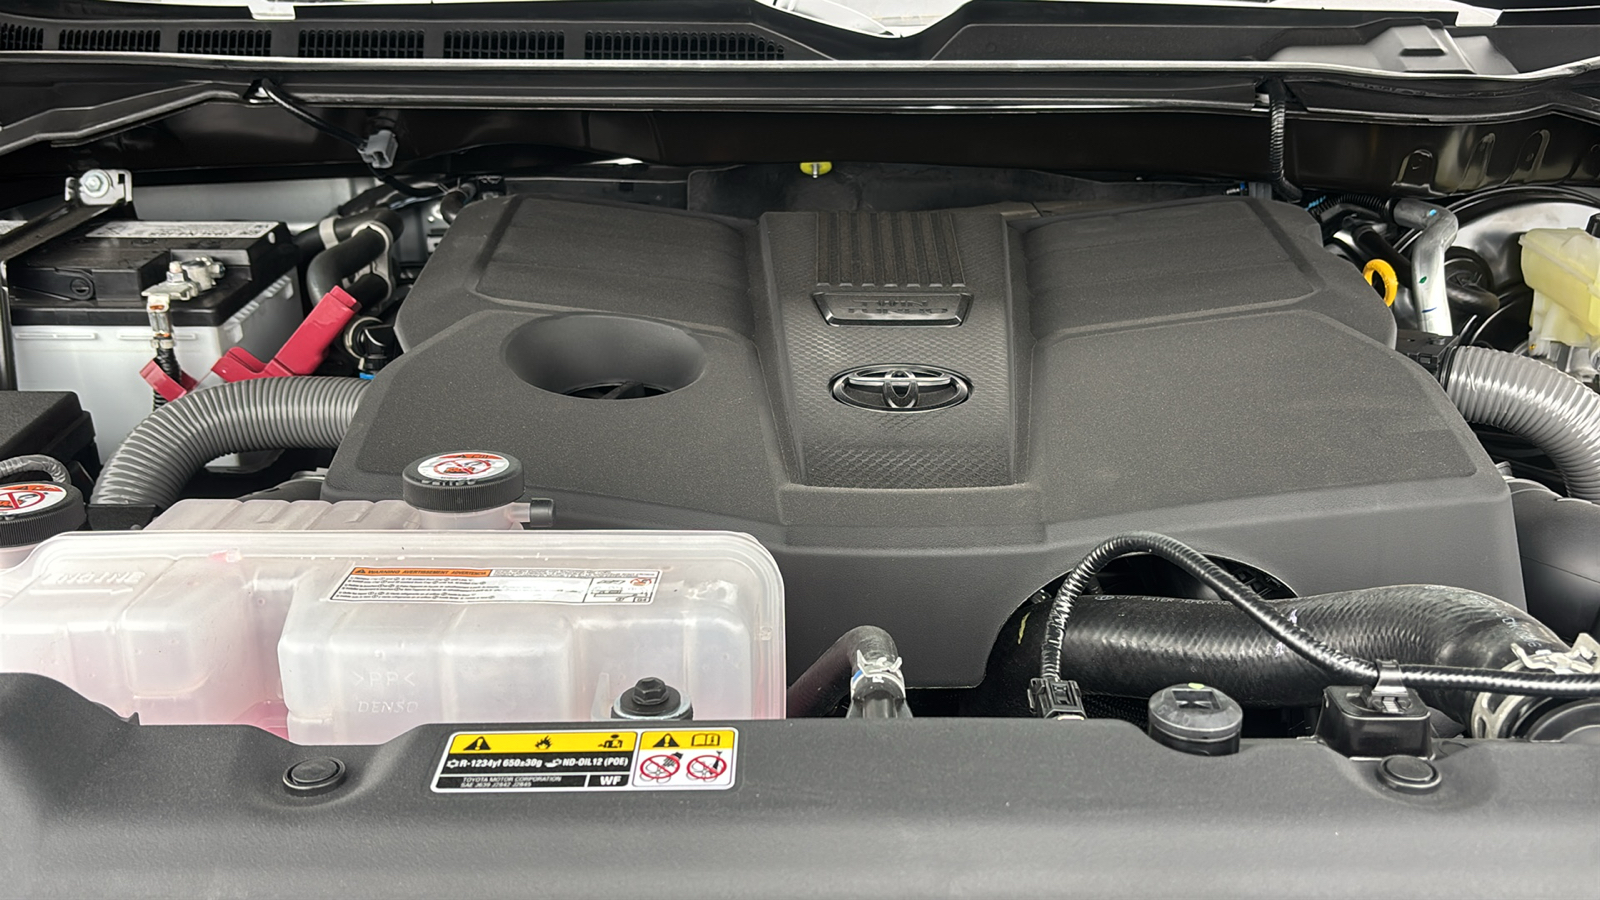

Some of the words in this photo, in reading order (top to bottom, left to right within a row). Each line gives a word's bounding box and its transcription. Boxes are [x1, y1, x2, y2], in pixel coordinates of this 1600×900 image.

[358, 701, 419, 713] DENSO
[460, 759, 503, 768] R-1234yf
[604, 757, 629, 767] (POE)
[600, 775, 622, 786] WF
